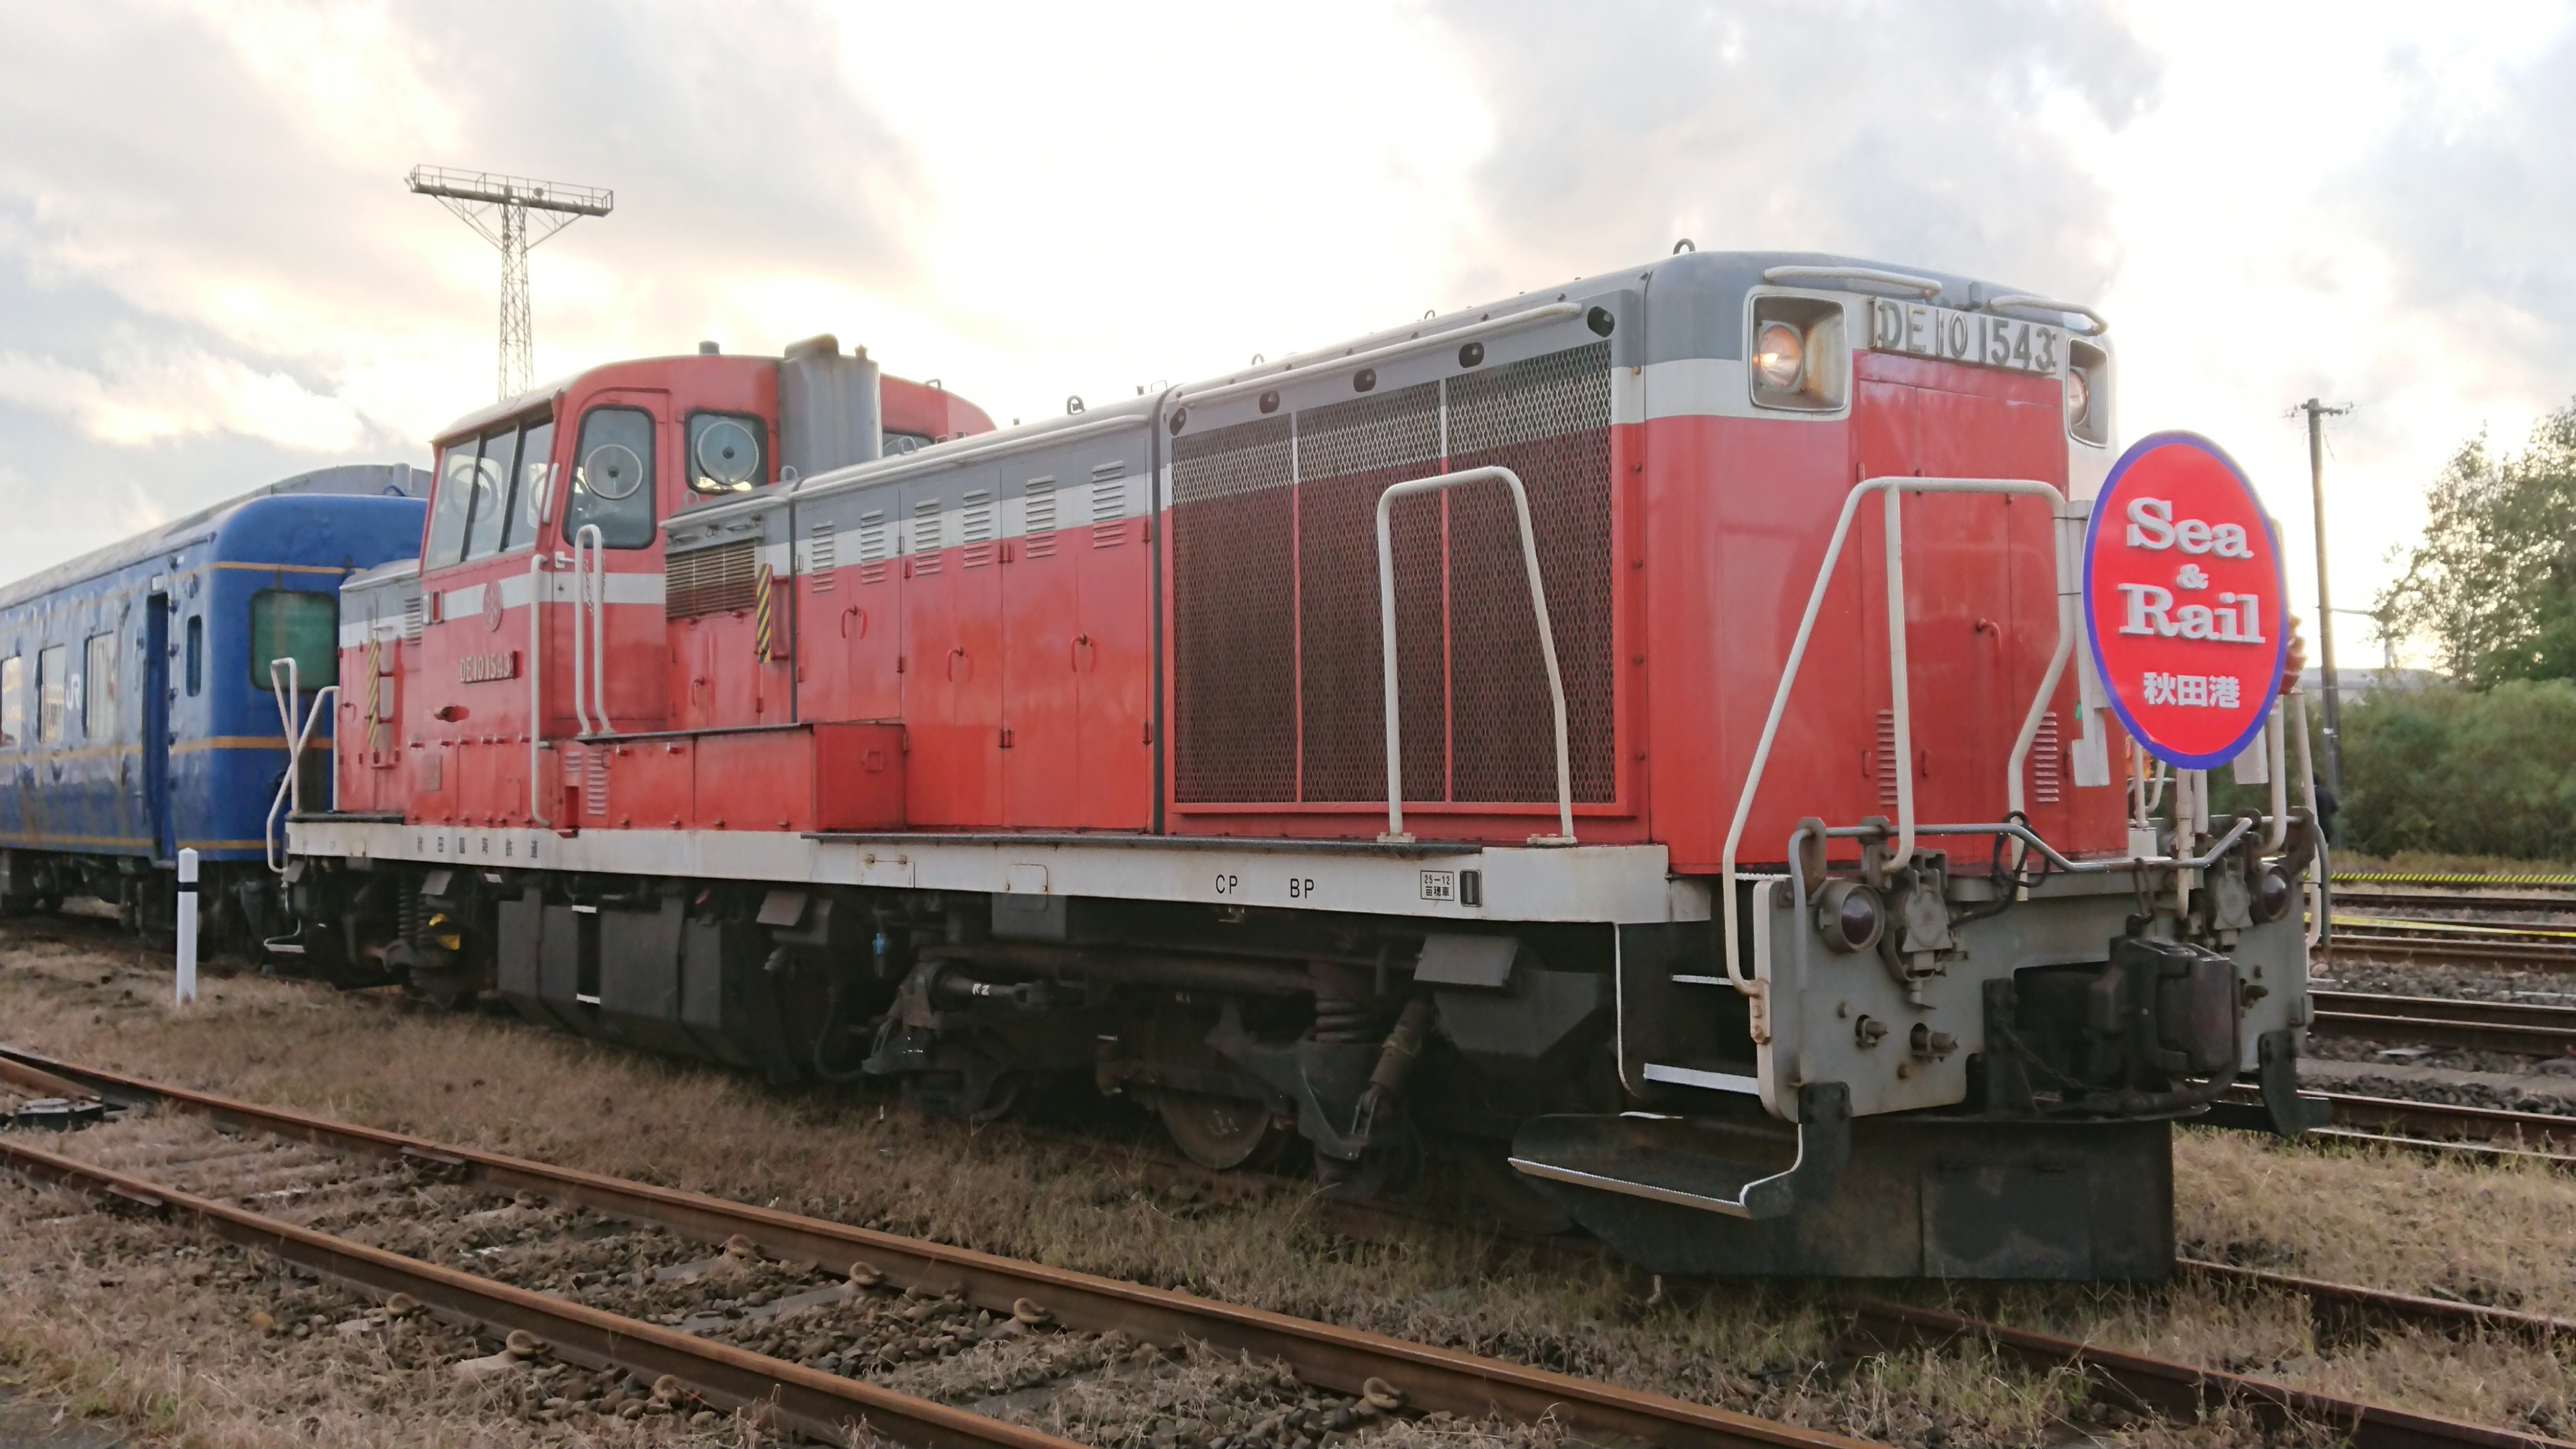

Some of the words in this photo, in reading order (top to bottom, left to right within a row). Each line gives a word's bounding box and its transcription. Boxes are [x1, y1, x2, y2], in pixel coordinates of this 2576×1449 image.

[1979, 316, 2053, 371] 1543
[2126, 497, 2255, 559] Sea
[2175, 564, 2208, 589] &
[2118, 583, 2266, 645] Rail
[66, 673, 80, 711] JR
[2143, 671, 2240, 708] 秋田港
[1216, 874, 1238, 895] CP
[1290, 878, 1314, 899] BP
